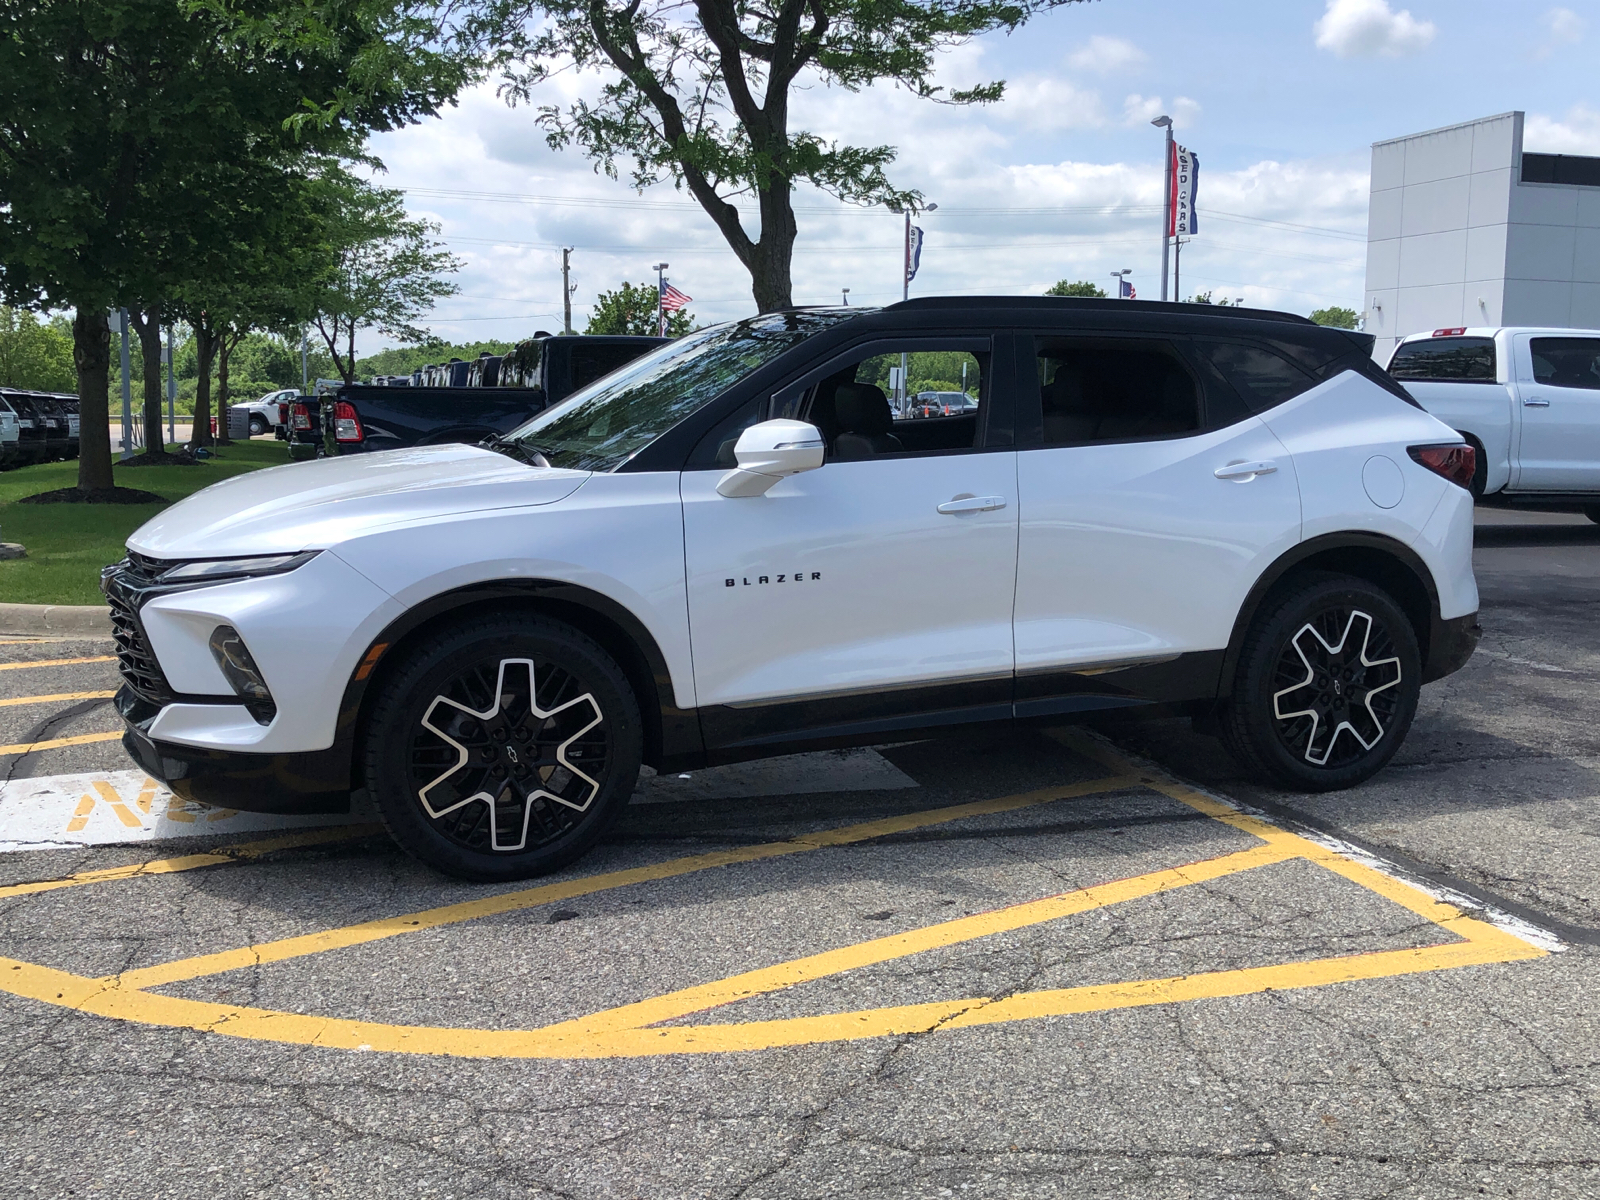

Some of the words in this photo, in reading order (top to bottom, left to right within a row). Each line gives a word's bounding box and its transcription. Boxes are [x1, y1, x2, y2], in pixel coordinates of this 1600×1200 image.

[1178, 145, 1188, 184] USED
[1178, 191, 1187, 232] CARS
[725, 572, 821, 587] BLAZER
